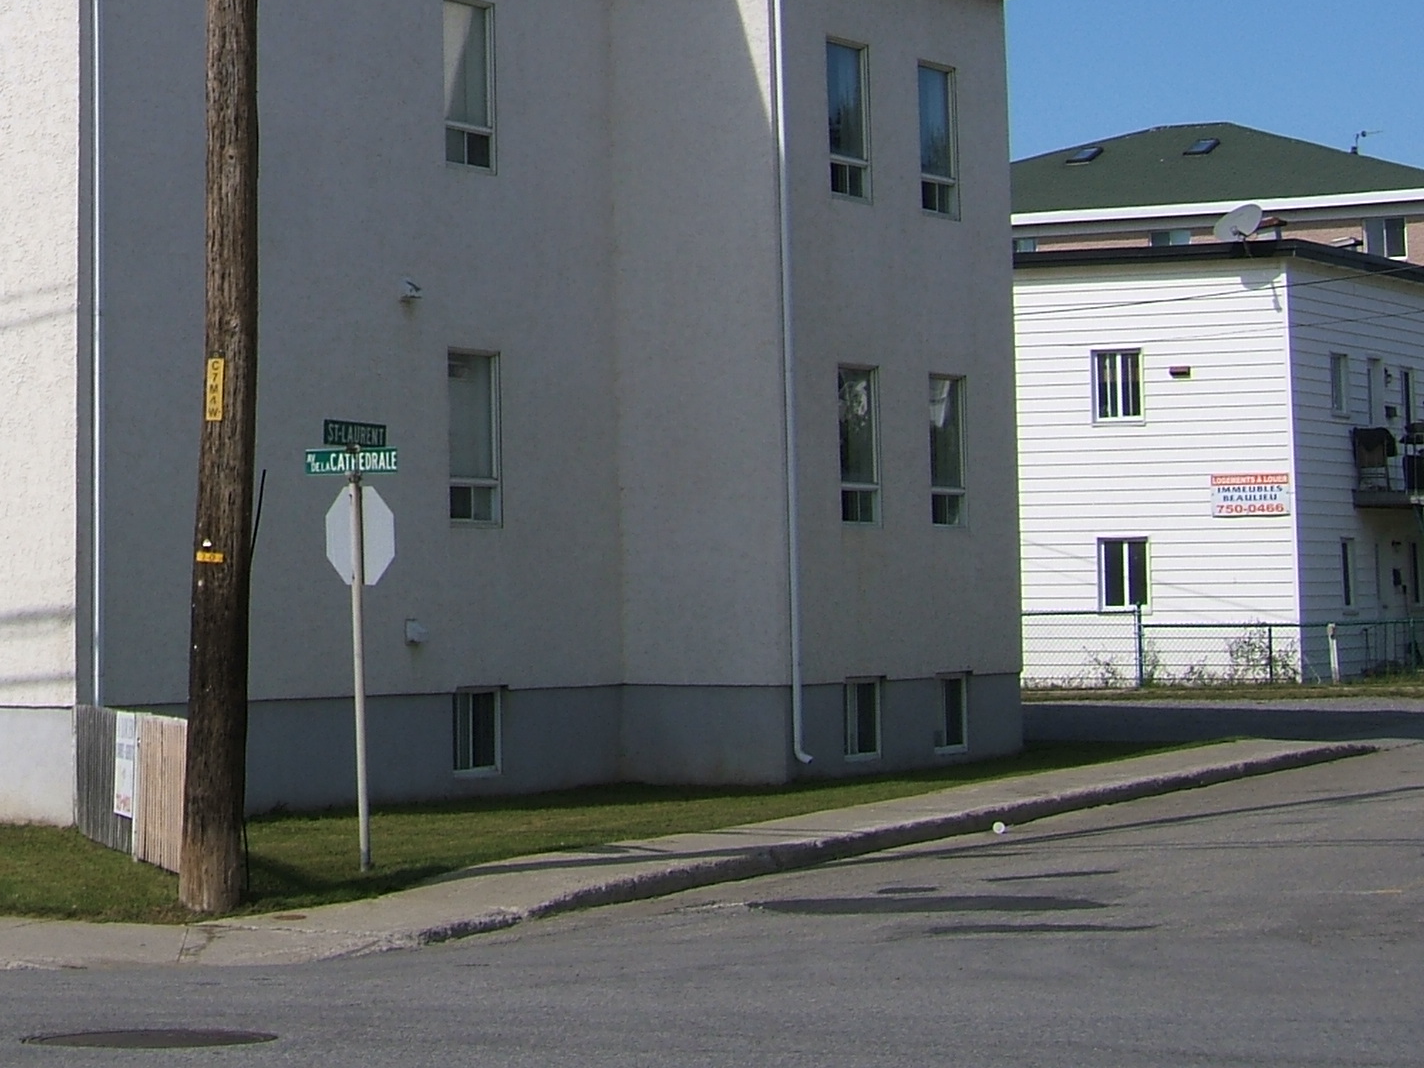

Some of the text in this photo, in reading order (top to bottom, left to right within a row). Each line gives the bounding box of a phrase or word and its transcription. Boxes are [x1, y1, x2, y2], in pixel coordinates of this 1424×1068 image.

[327, 423, 384, 445] ST-LAURENT
[1264, 475, 1287, 483] LOUER
[1217, 485, 1283, 493] IMMEUBLES
[1223, 493, 1277, 502] BEAULIEU
[1216, 503, 1284, 513] 750-0466
